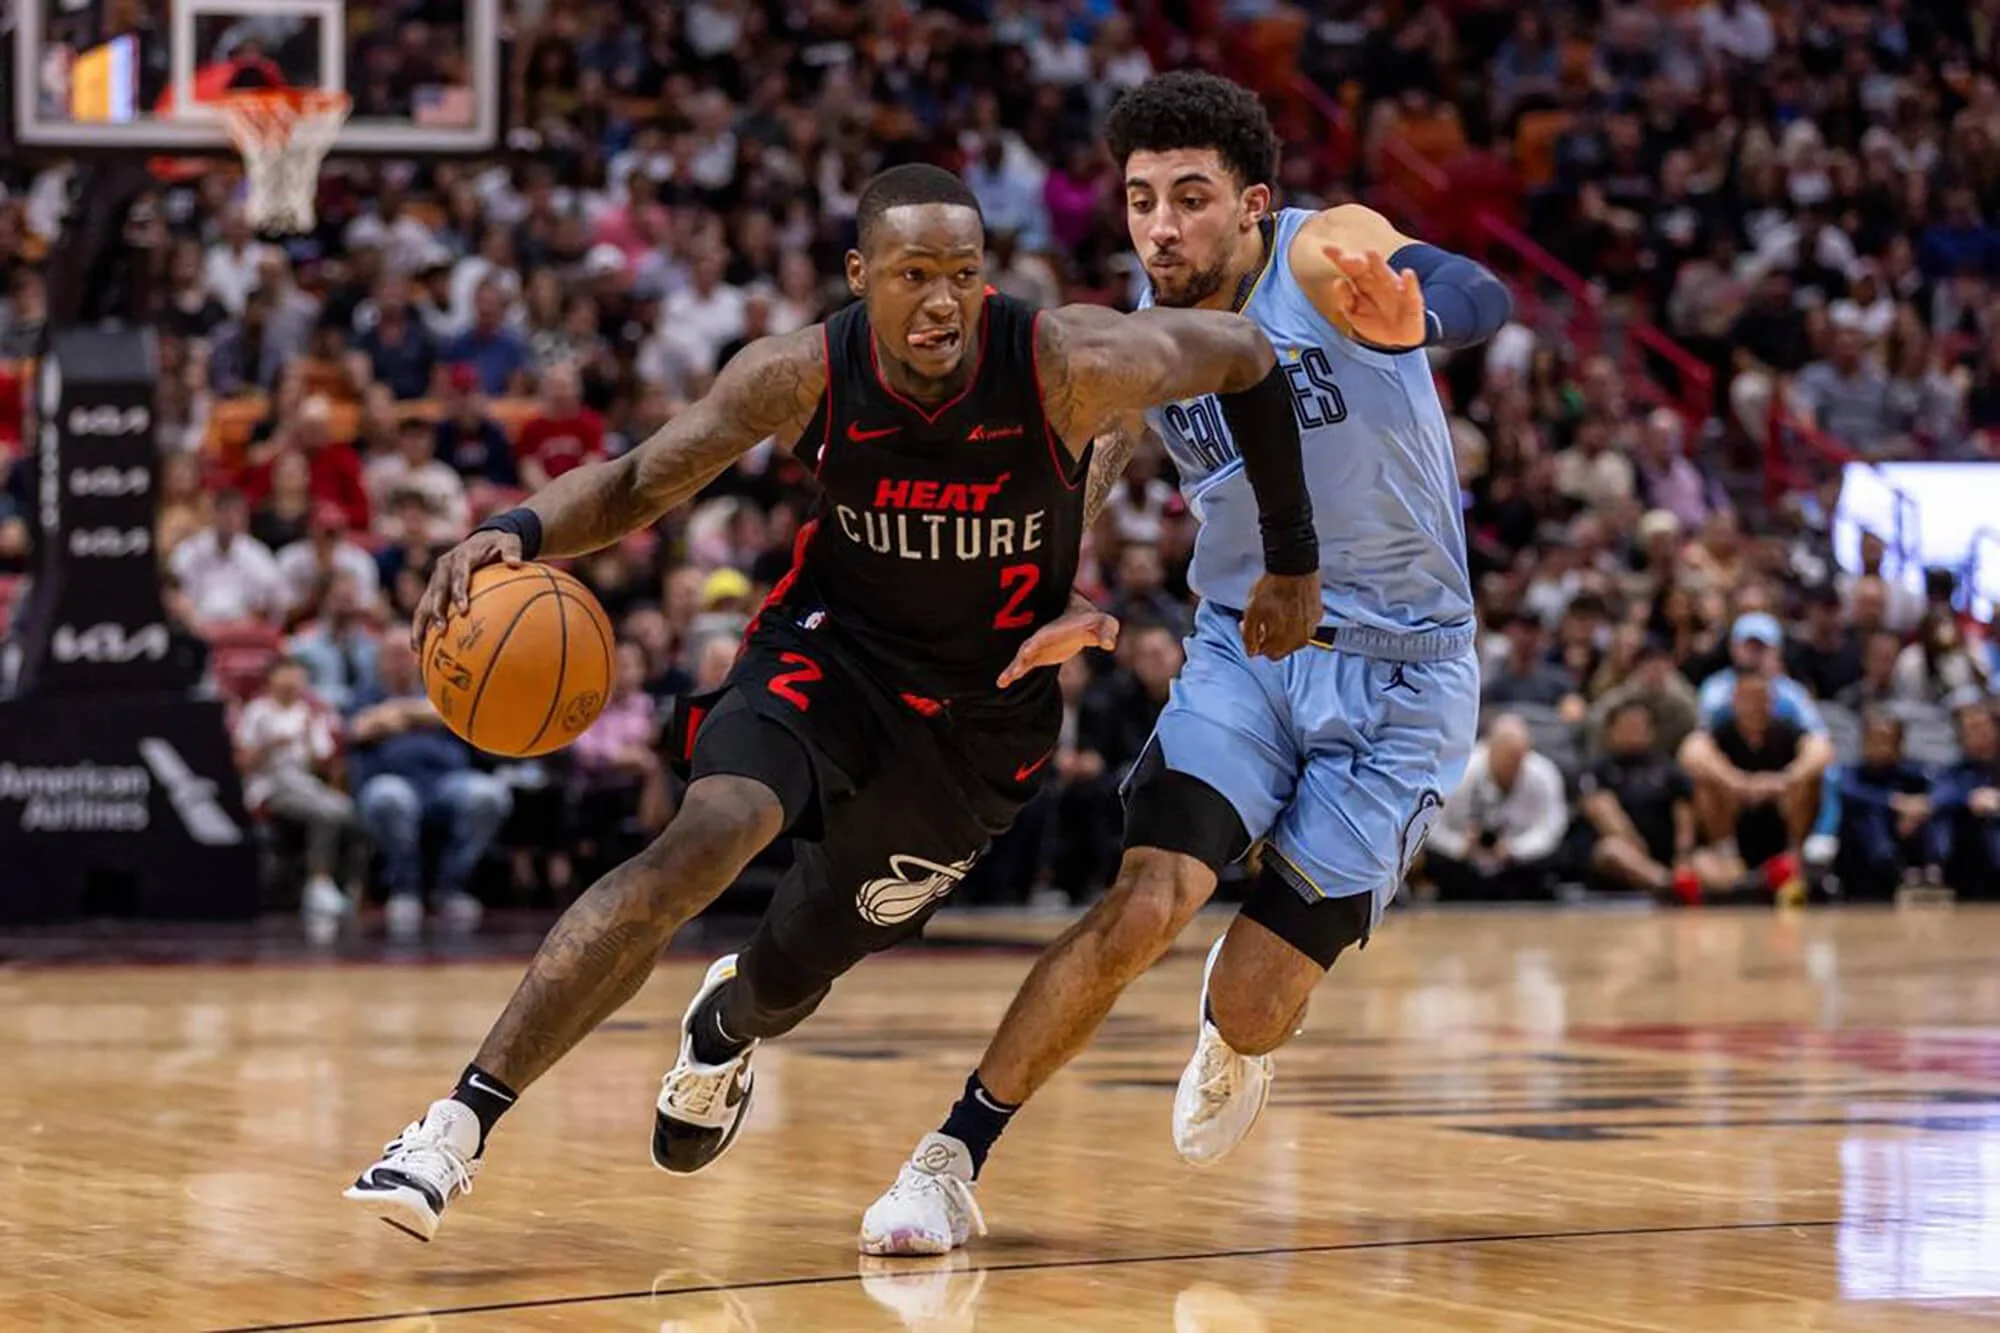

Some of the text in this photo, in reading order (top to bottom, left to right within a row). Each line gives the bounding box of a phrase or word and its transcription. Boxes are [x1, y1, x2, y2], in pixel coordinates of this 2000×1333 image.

[873, 472, 1011, 512] HEAT
[837, 504, 1045, 561] CULTURE
[993, 563, 1040, 630] 2
[767, 652, 823, 713] 2
[0, 760, 149, 799] American
[21, 797, 149, 831] Airlines
